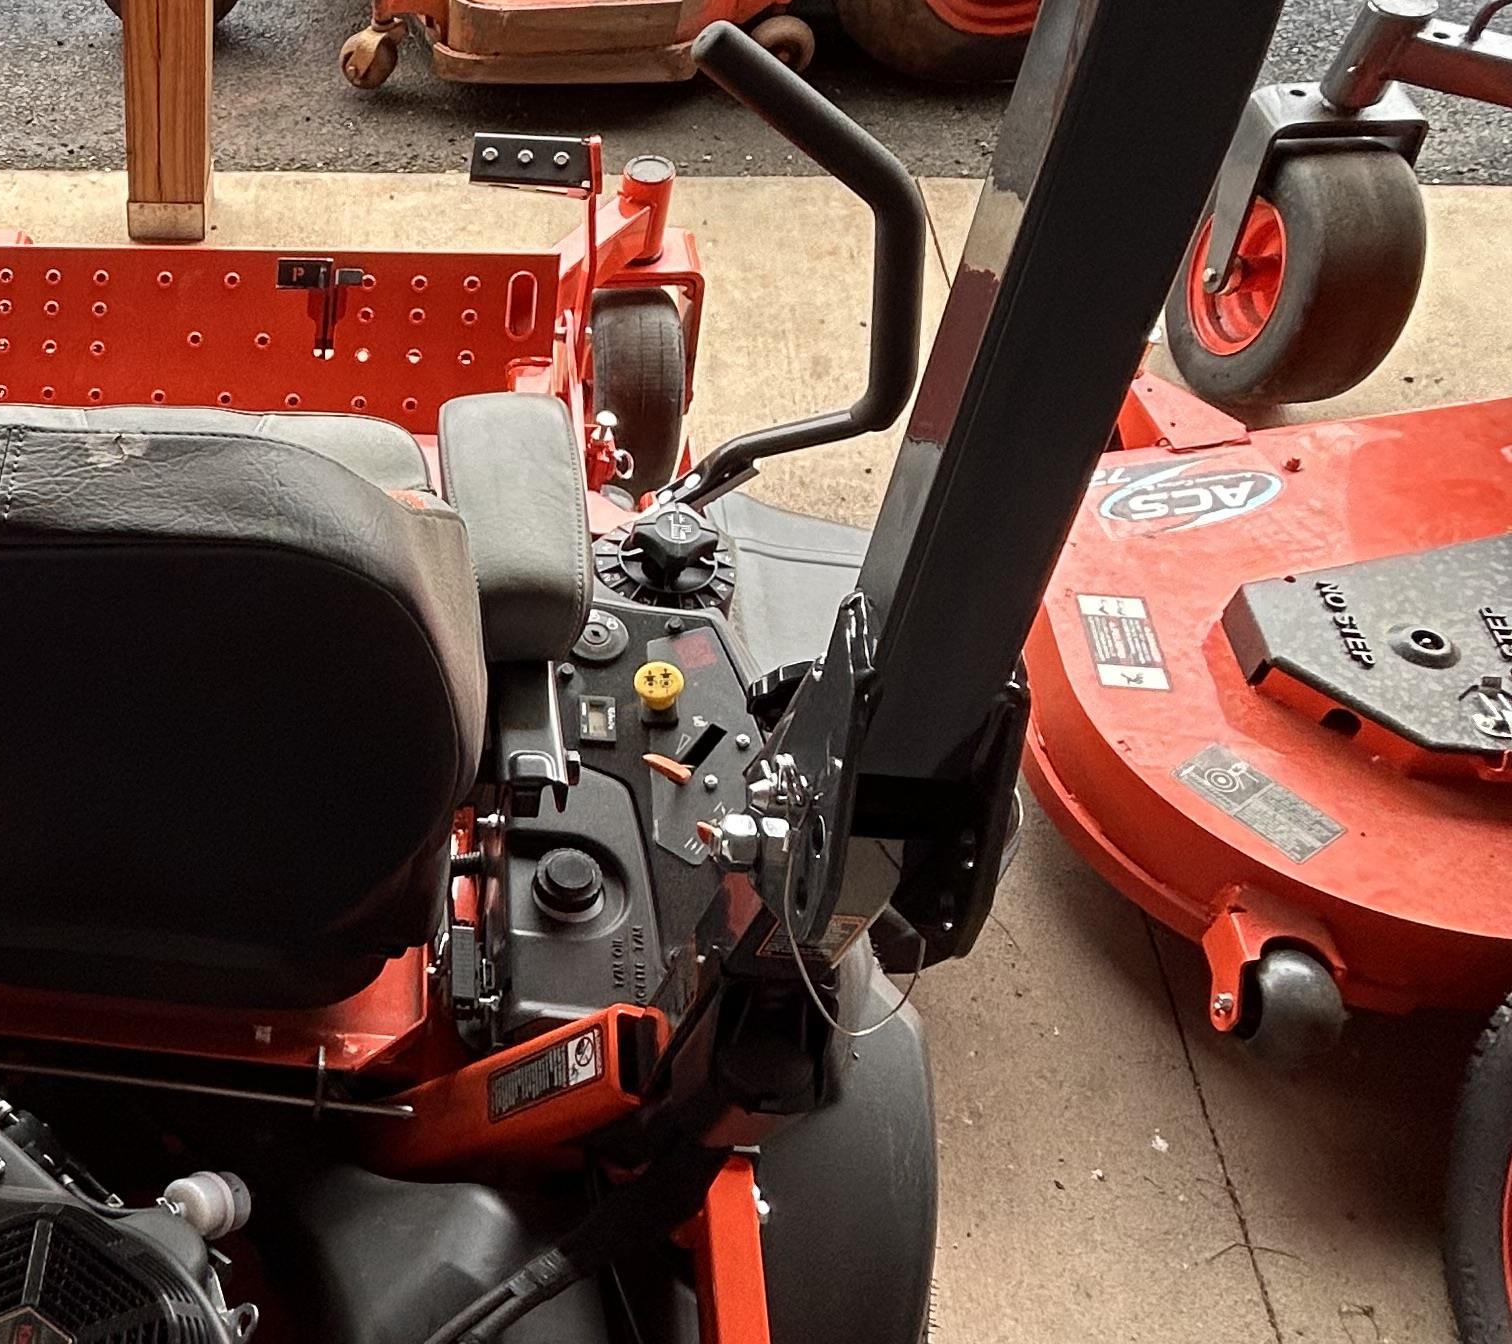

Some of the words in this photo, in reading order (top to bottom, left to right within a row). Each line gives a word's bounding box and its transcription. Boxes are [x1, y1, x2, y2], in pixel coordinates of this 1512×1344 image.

[1128, 480, 1257, 521] ACS
[1316, 580, 1348, 612] NO
[1333, 612, 1376, 670] STEP
